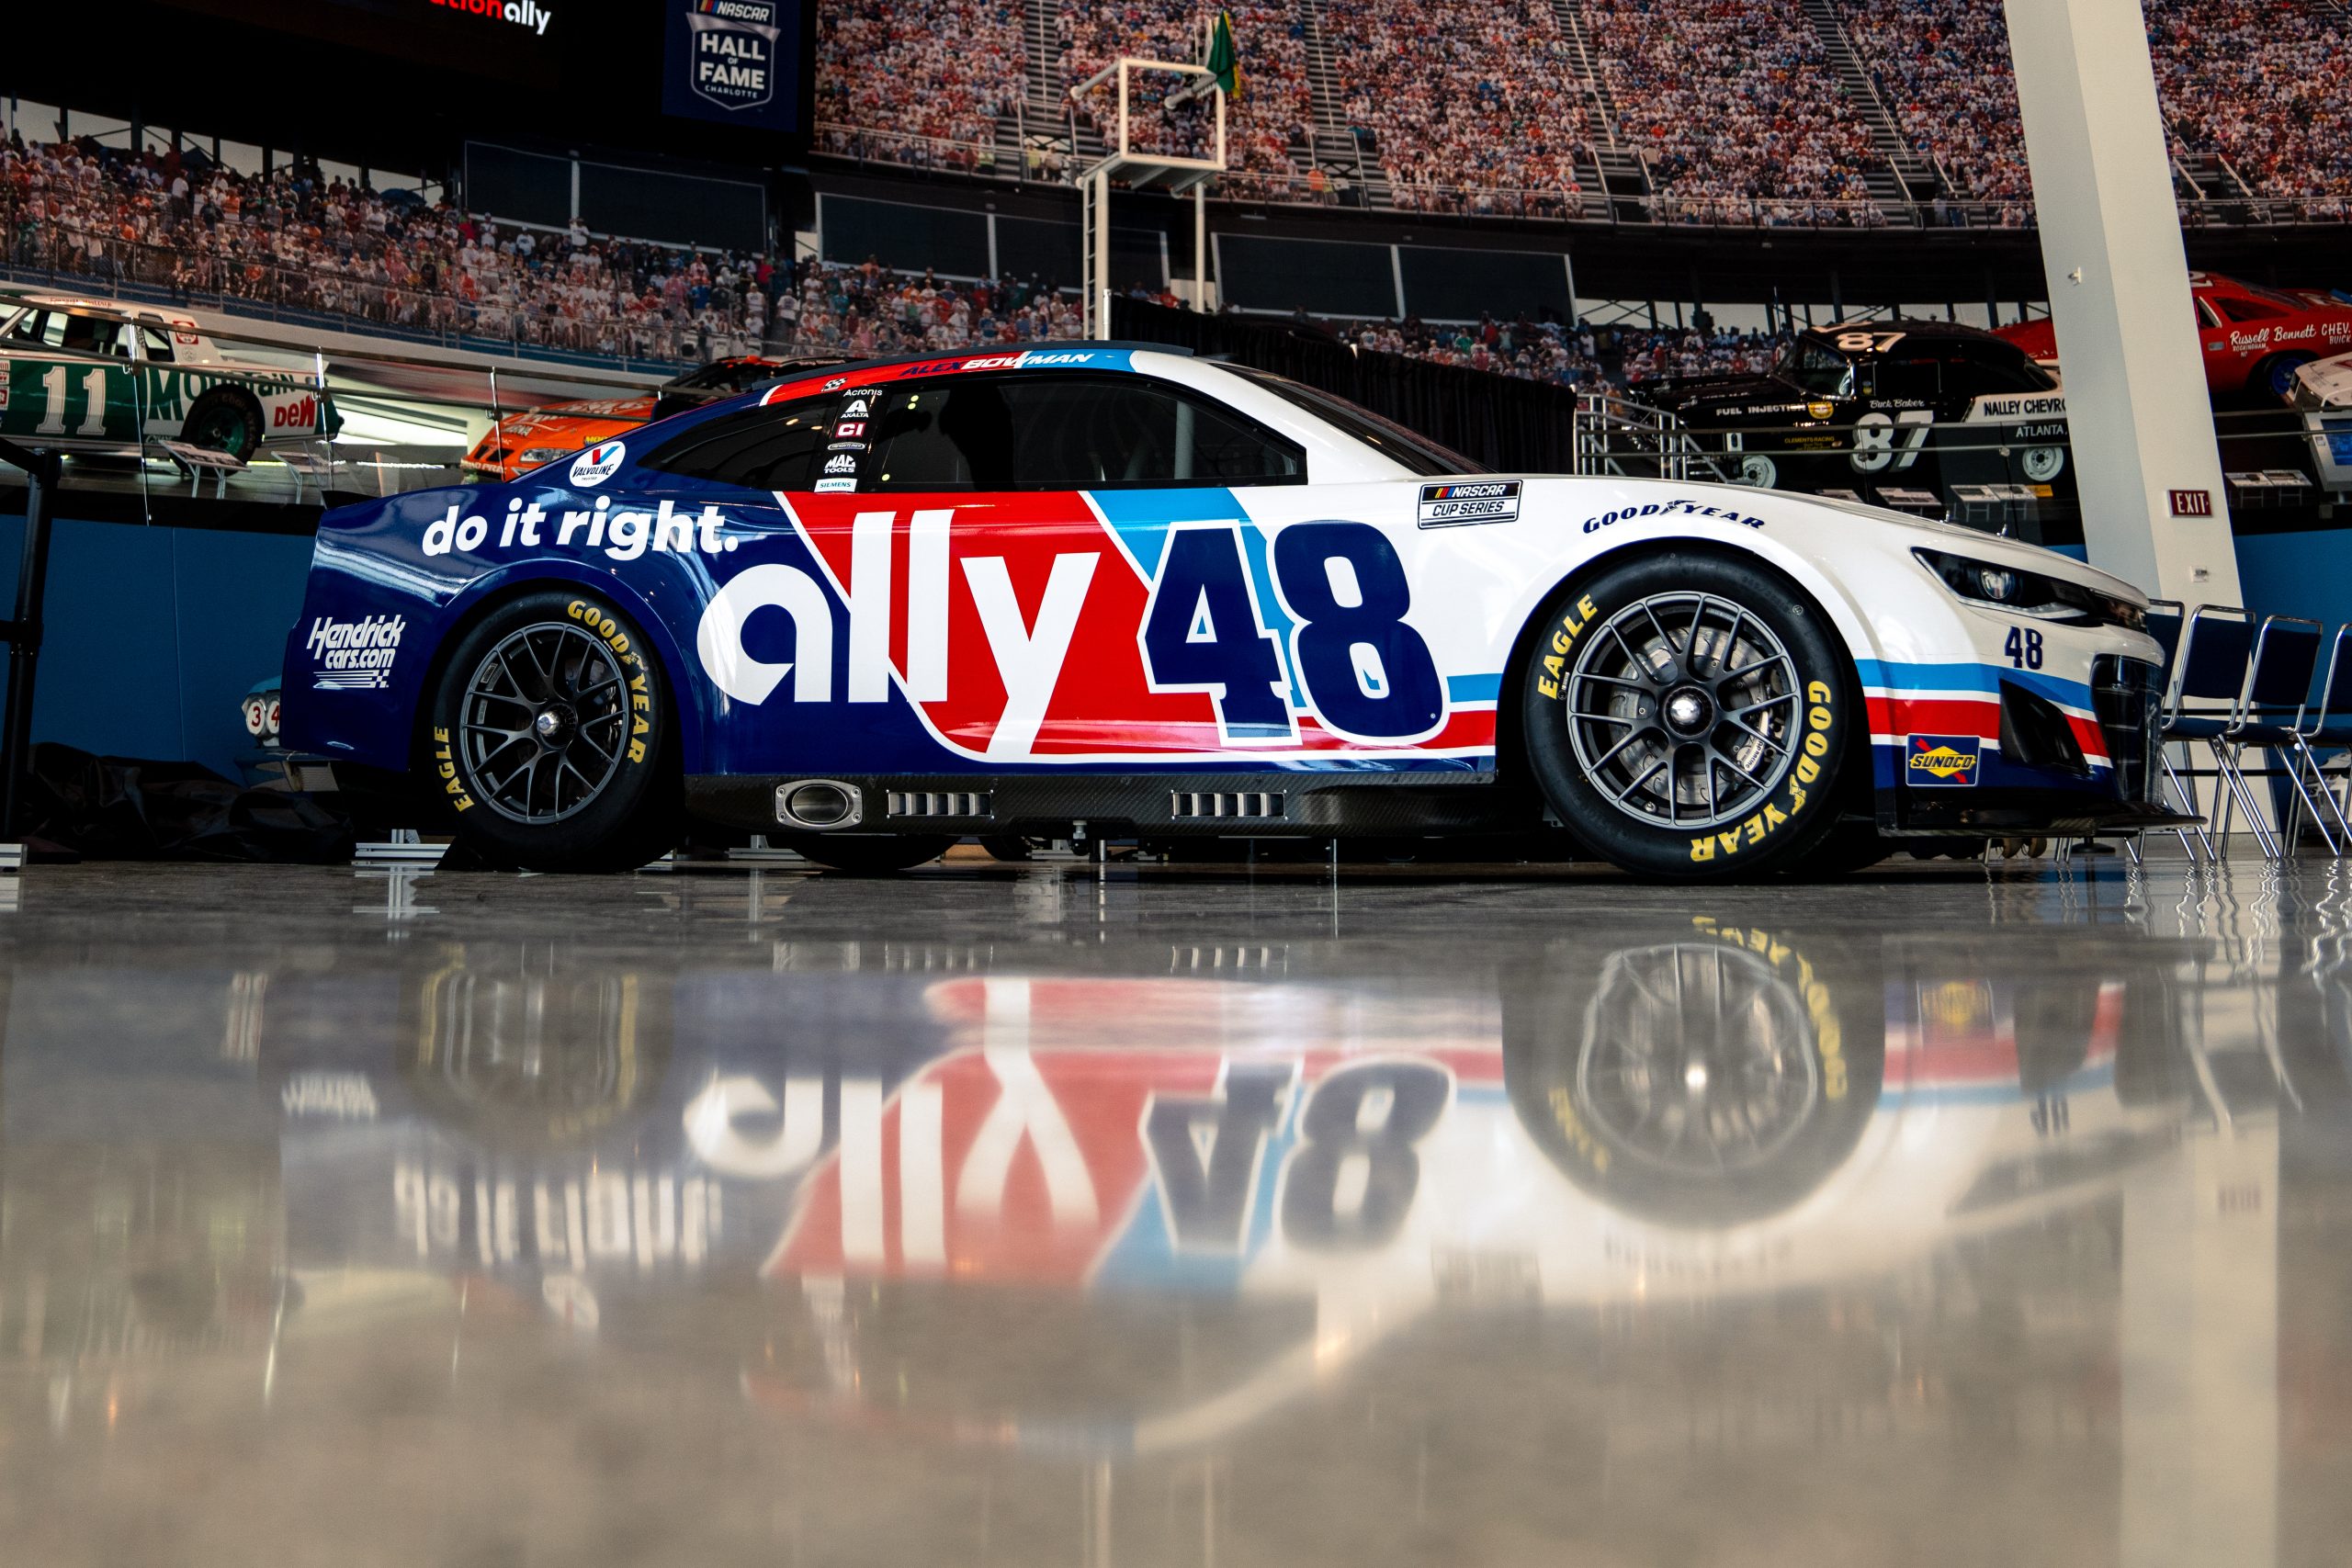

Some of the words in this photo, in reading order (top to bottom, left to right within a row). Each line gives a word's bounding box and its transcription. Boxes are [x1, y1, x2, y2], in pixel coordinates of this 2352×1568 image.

[717, 1, 770, 21] NASCAR
[701, 32, 766, 61] HALL
[699, 62, 765, 89] FAME
[705, 85, 758, 98] CHARLOTTE
[1837, 332, 1906, 353] 87
[2230, 327, 2270, 345] Russell
[2274, 324, 2316, 342] Bennett
[2321, 321, 2351, 336] CHEV.
[899, 362, 964, 377] ALEX
[961, 351, 1095, 369] BOWMAN
[36, 367, 106, 436] 11
[843, 389, 882, 398] Acronis
[1716, 408, 1742, 417] FUEL
[1870, 399, 1893, 409] Buck
[1894, 399, 1925, 408] Baker
[1984, 400, 2021, 417] NALLEY
[838, 423, 865, 436] CI
[1850, 410, 1934, 473] 87
[572, 463, 614, 478] VALVOLINE
[824, 454, 856, 468] MAC
[1453, 485, 1507, 498] NASCAR
[1433, 504, 1459, 516] CUP
[1459, 501, 1504, 514] SERIES
[2176, 493, 2206, 513] EXIT
[422, 504, 488, 557] do
[499, 497, 547, 547] it
[556, 495, 739, 561] right.
[306, 615, 406, 660] Hendrick
[696, 508, 1102, 754] ally
[1139, 519, 1448, 746] 48
[1537, 593, 1599, 699] EAGLE
[2004, 626, 2043, 670] 48
[324, 649, 396, 669] cars.com
[434, 726, 475, 813] EAGLE
[1911, 754, 1975, 769] SUNOCO
